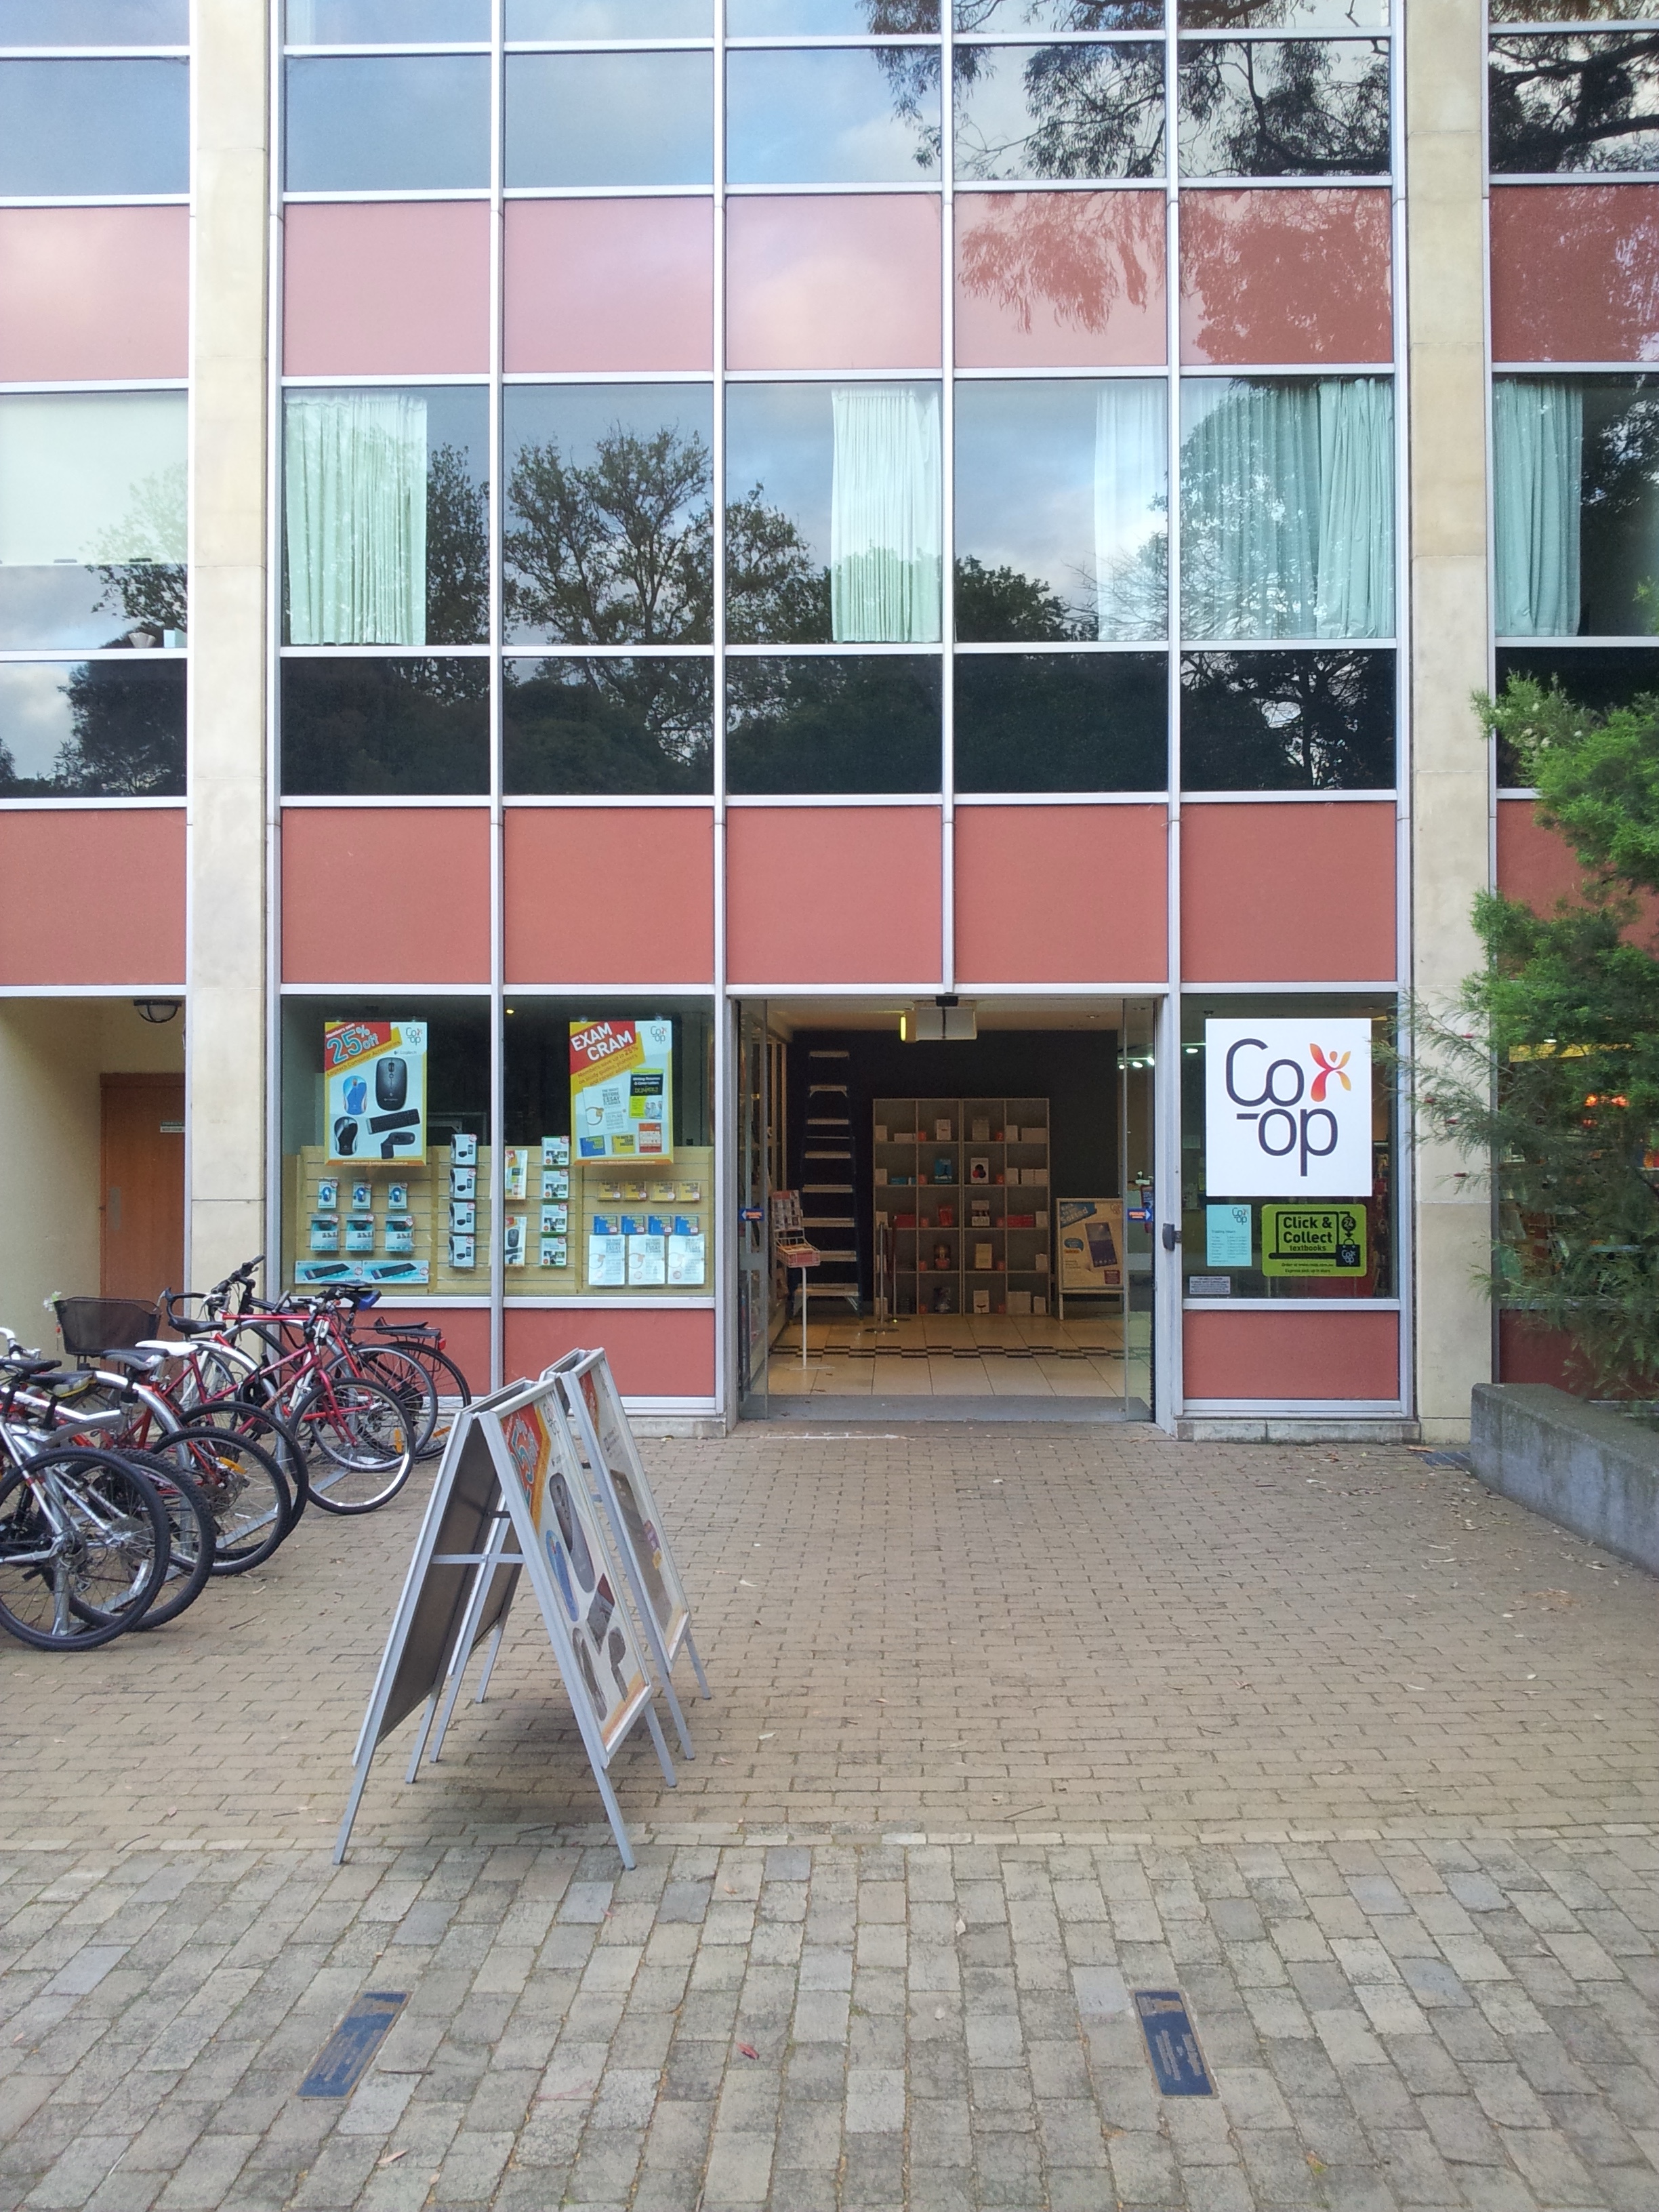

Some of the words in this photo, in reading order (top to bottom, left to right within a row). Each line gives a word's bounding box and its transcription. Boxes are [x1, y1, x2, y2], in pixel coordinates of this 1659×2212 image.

[327, 1024, 371, 1064] 25%
[362, 1032, 380, 1050] off
[570, 1022, 613, 1051] EXAM
[587, 1030, 634, 1061] CRAM
[1225, 1038, 1305, 1107] Co
[1283, 1216, 1319, 1229] Click
[1322, 1216, 1333, 1229] &
[1343, 1220, 1354, 1228] 24
[1283, 1231, 1332, 1244] Collect
